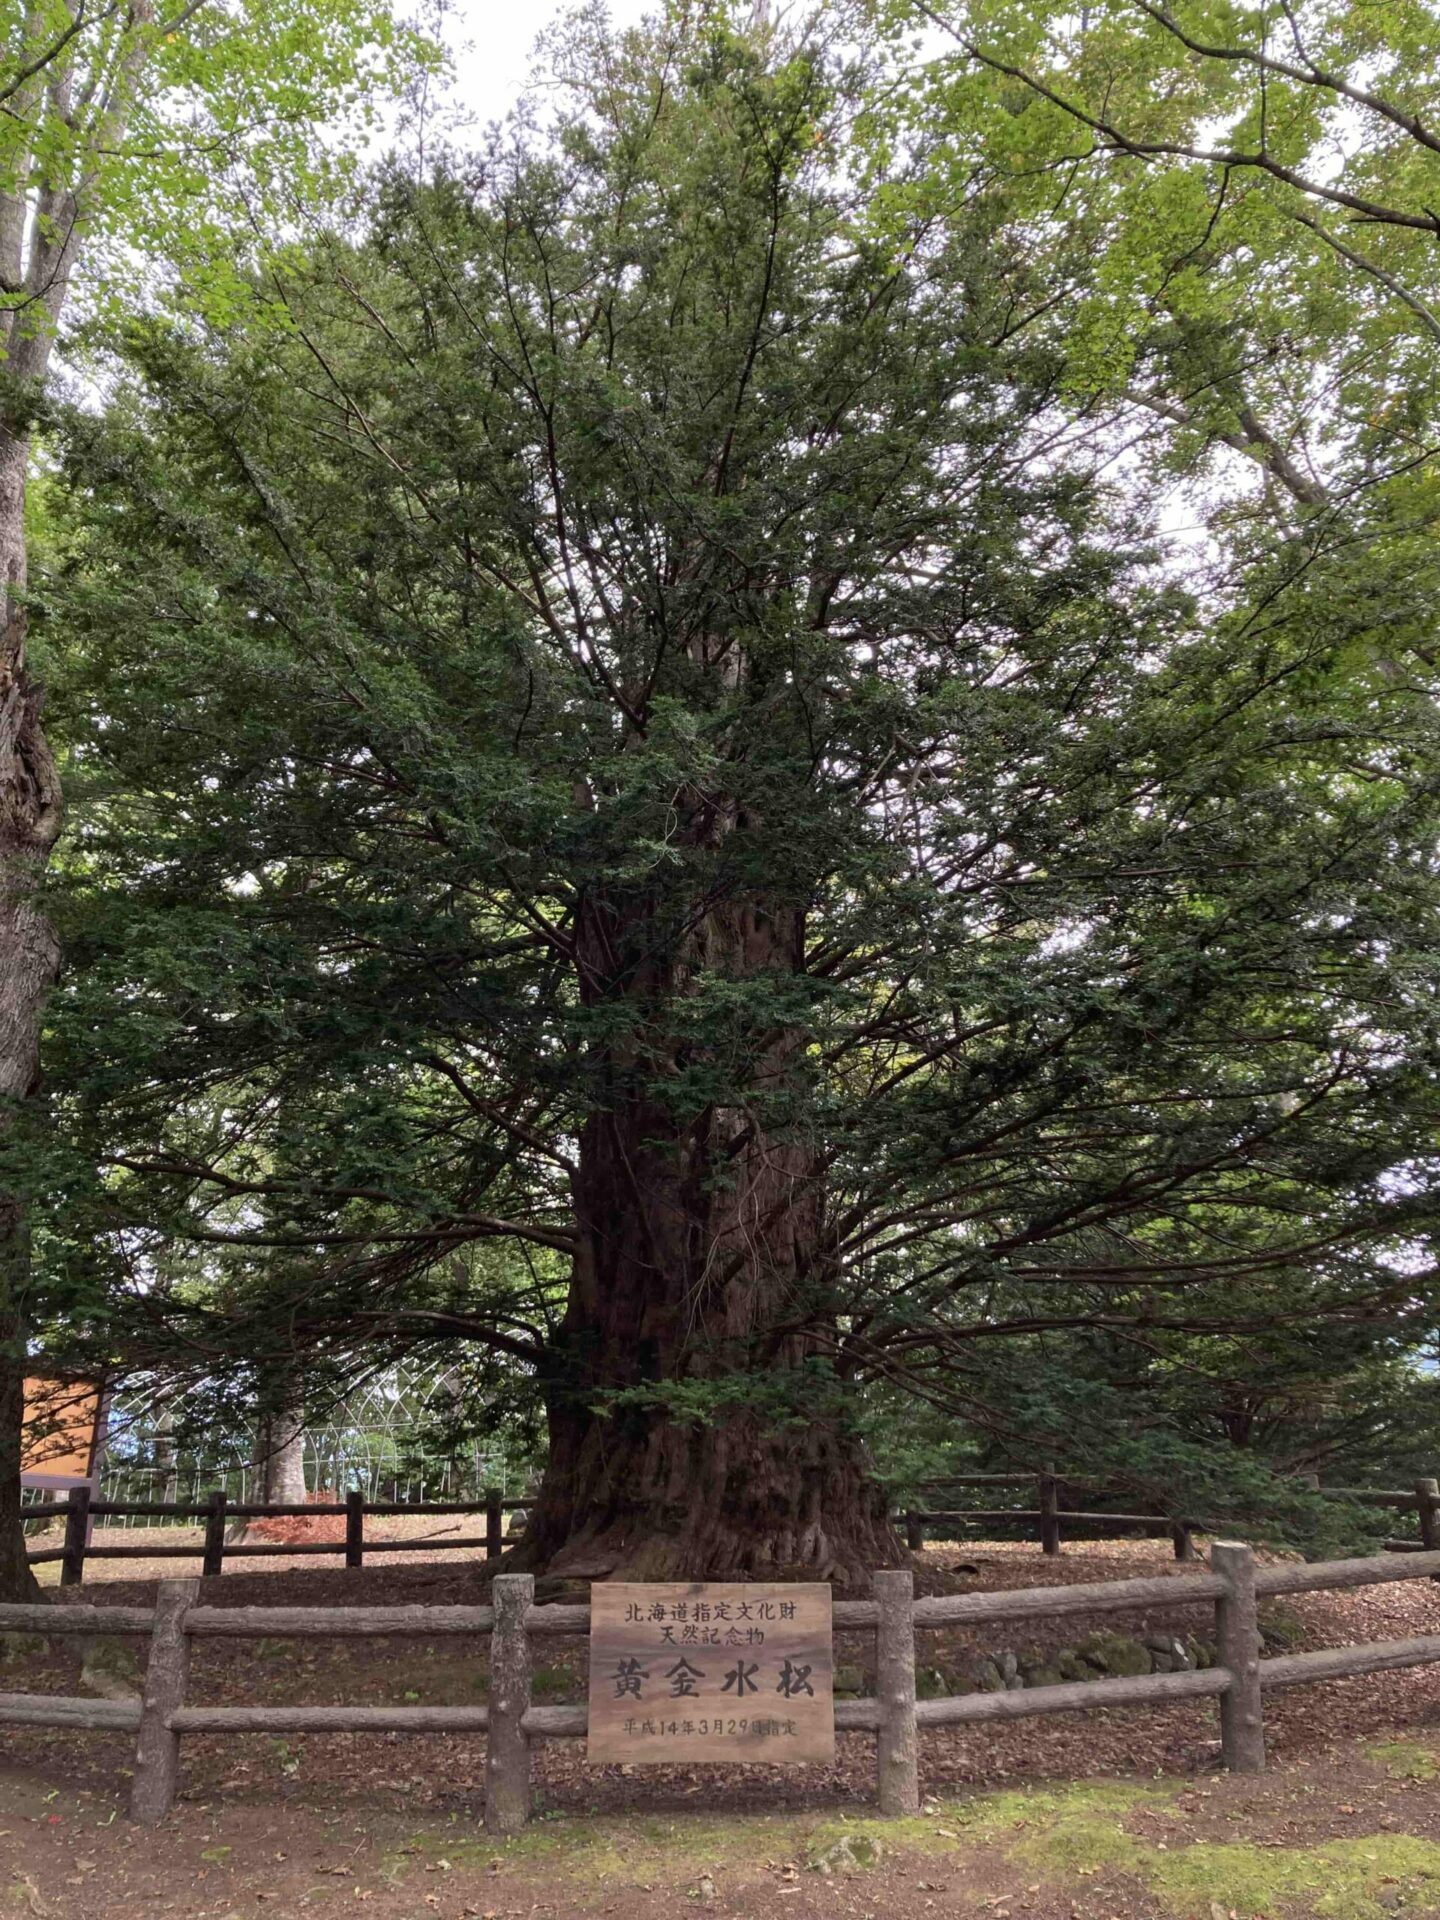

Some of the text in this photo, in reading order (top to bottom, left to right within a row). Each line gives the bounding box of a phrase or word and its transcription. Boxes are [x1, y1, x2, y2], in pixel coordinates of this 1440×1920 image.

[625, 1601, 797, 1623] 北海道指定文化財
[660, 1624, 765, 1646] 天然記念物
[610, 1656, 815, 1700] 黄金水松
[622, 1718, 798, 1737] 平成14年3月29日指定
